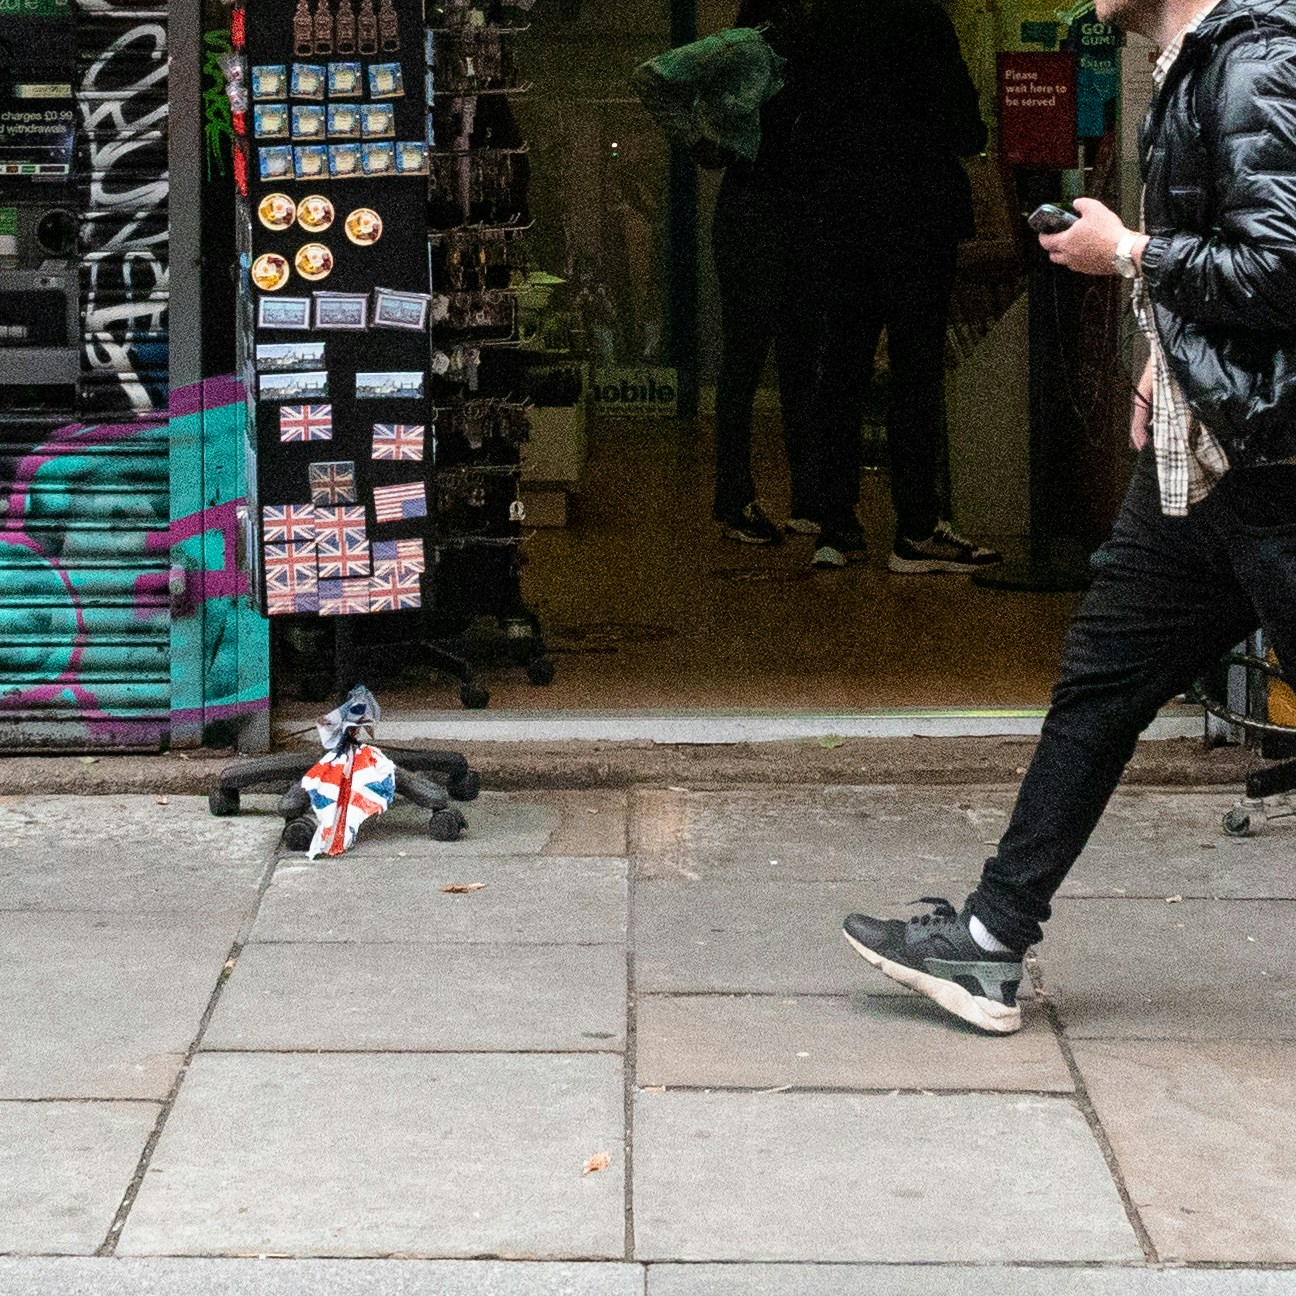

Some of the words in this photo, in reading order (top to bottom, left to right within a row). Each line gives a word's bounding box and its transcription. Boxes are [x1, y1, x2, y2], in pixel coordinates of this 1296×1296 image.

[1004, 69, 1038, 81] Please
[1005, 82, 1028, 94] wait
[1030, 82, 1053, 94] here
[1055, 84, 1067, 94] to
[1005, 95, 1019, 106] be
[1021, 95, 1056, 107] served
[1, 110, 42, 124] charges
[6, 124, 67, 136] withdrawals
